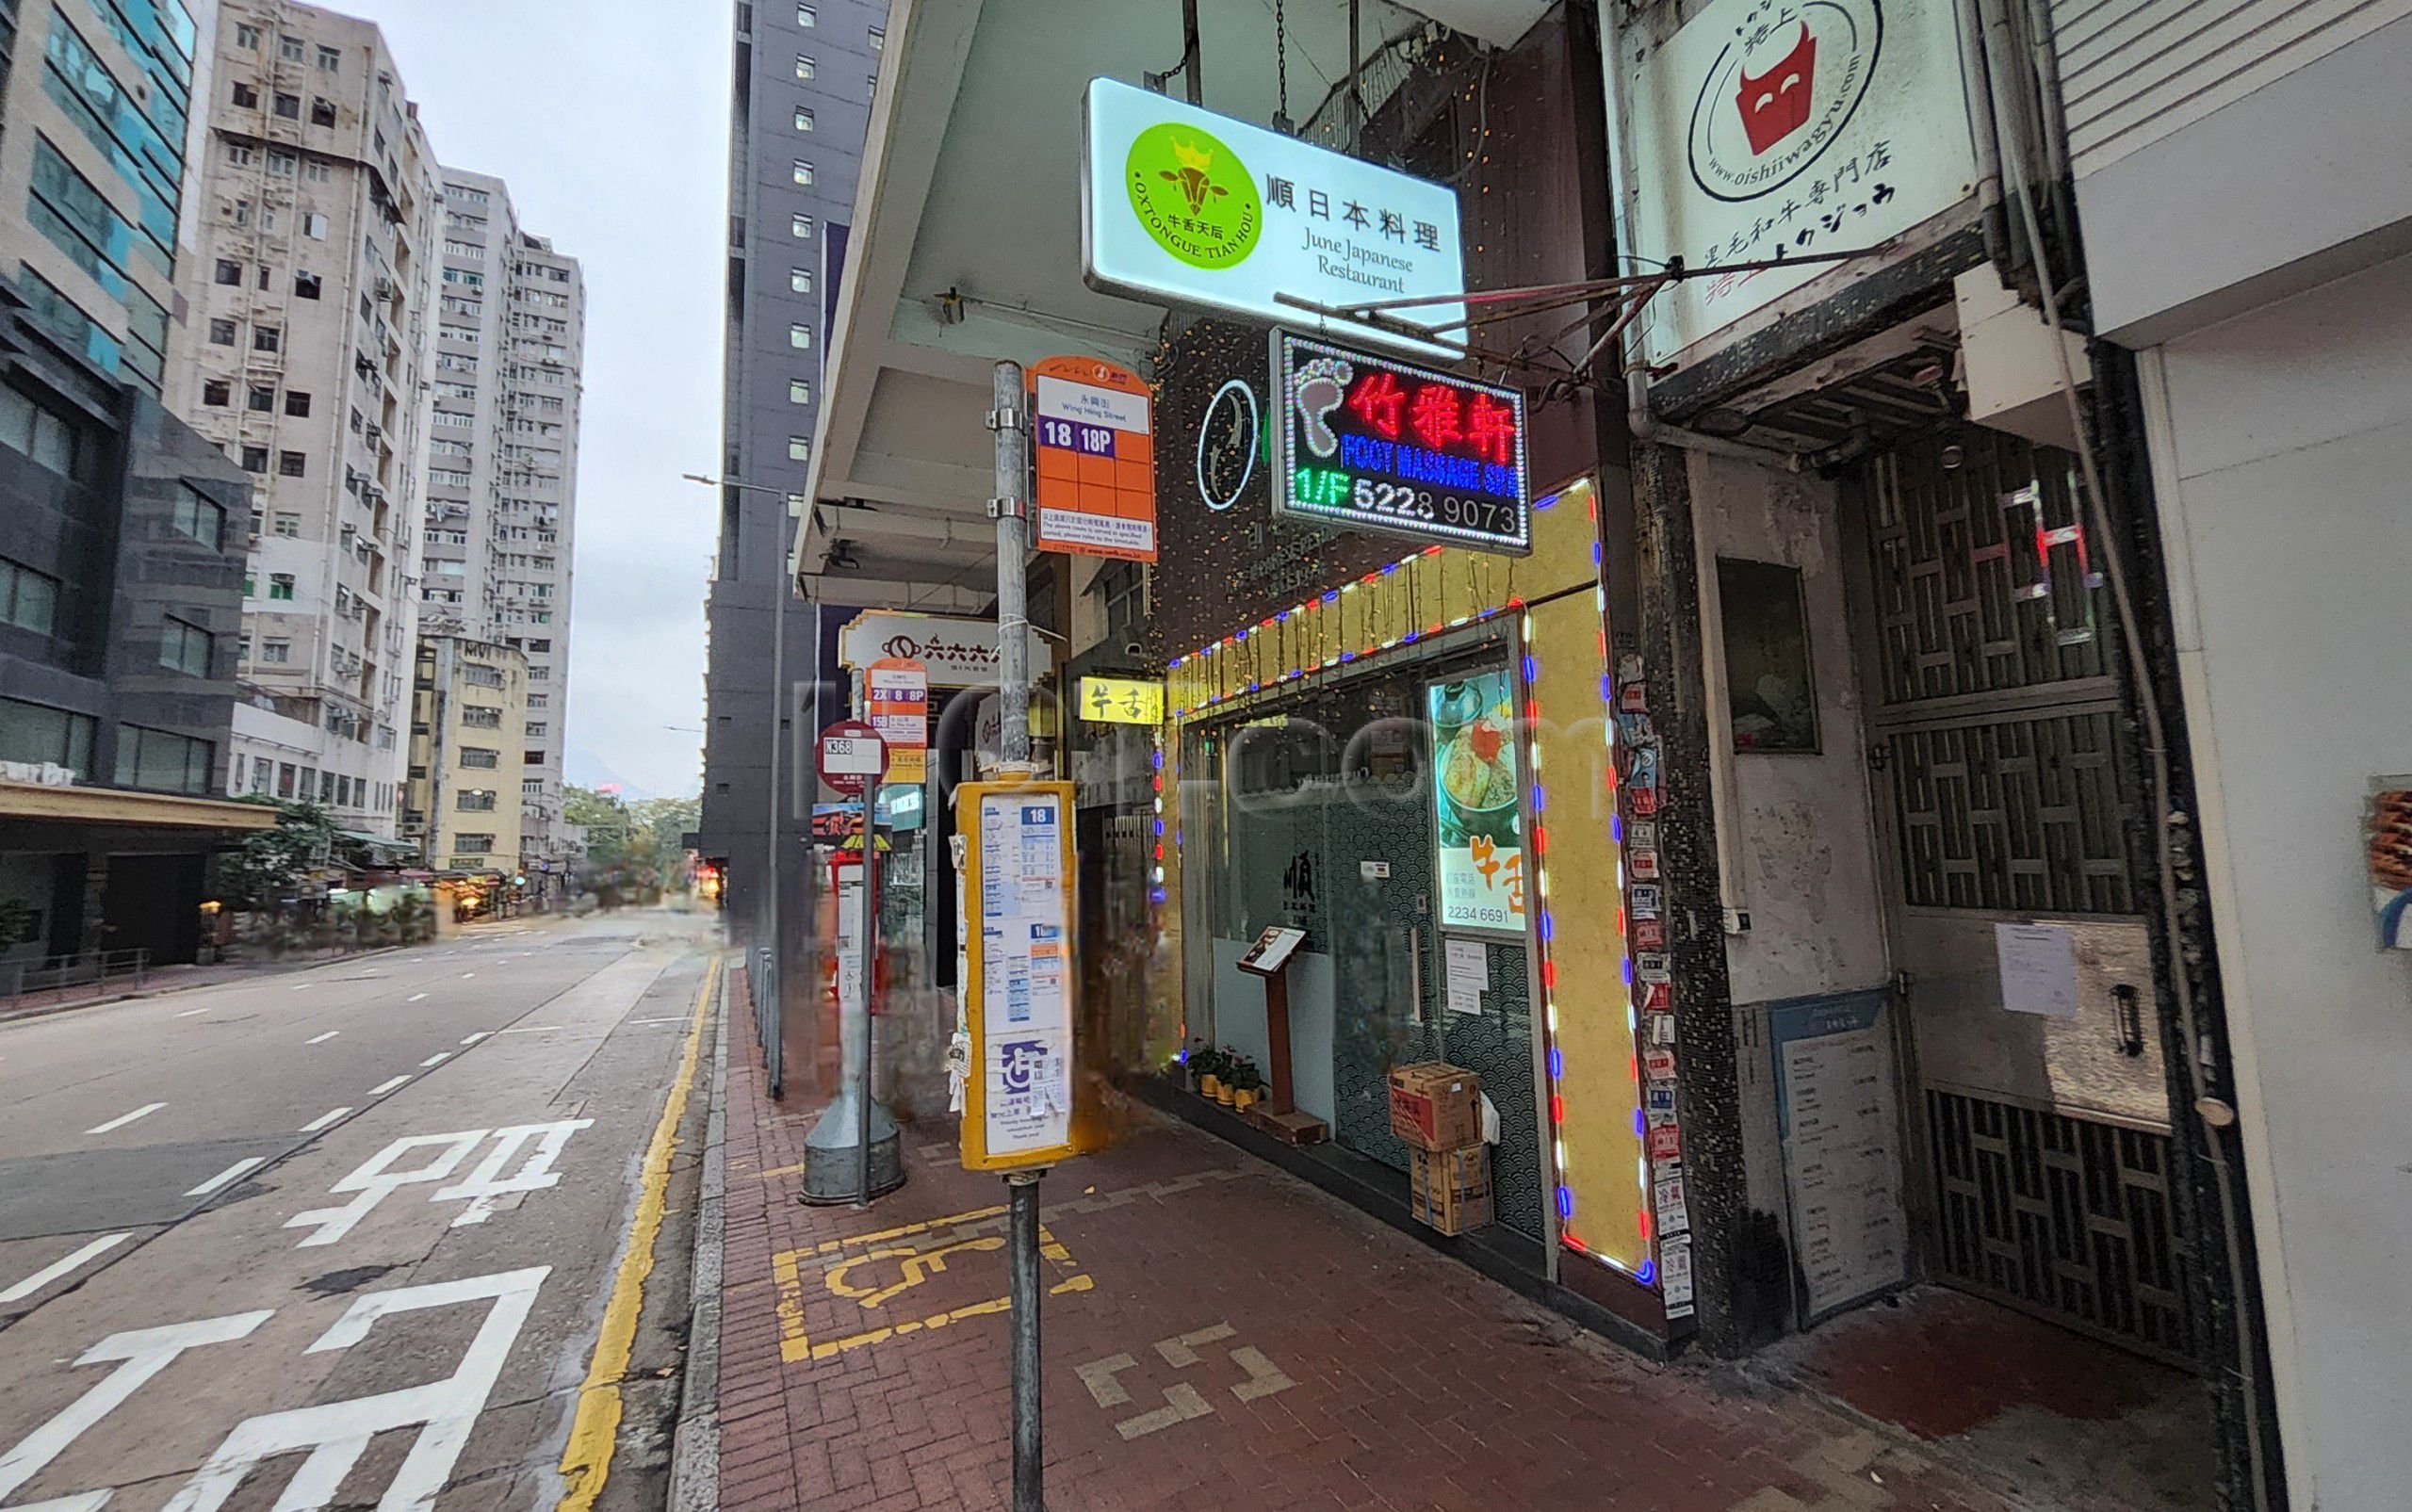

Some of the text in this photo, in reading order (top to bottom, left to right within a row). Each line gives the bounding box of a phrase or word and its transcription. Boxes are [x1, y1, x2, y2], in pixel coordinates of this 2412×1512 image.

[1708, 54, 1861, 186] www.oishiiwagyu.com
[1135, 182, 1202, 258] OXTONGUE
[1167, 214, 1224, 241] 牛舌天后
[1266, 173, 1442, 252] 順日本料理
[1301, 227, 1413, 273] June Japanese
[1319, 255, 1406, 294] Restaurant
[1061, 401, 1083, 415] Wing
[1349, 373, 1516, 465] 竹雅軒
[1044, 421, 1112, 453] 18 18P
[1341, 432, 1394, 474] FOOT
[1296, 467, 1516, 534] 1/F 5228 9073
[872, 689, 924, 701] 2X 8 8P
[1090, 682, 1146, 720] 牛舌
[825, 740, 853, 755] N368
[1030, 808, 1047, 823] 18
[1447, 905, 1508, 923] 2234 6691
[282, 1118, 595, 1248] 站
